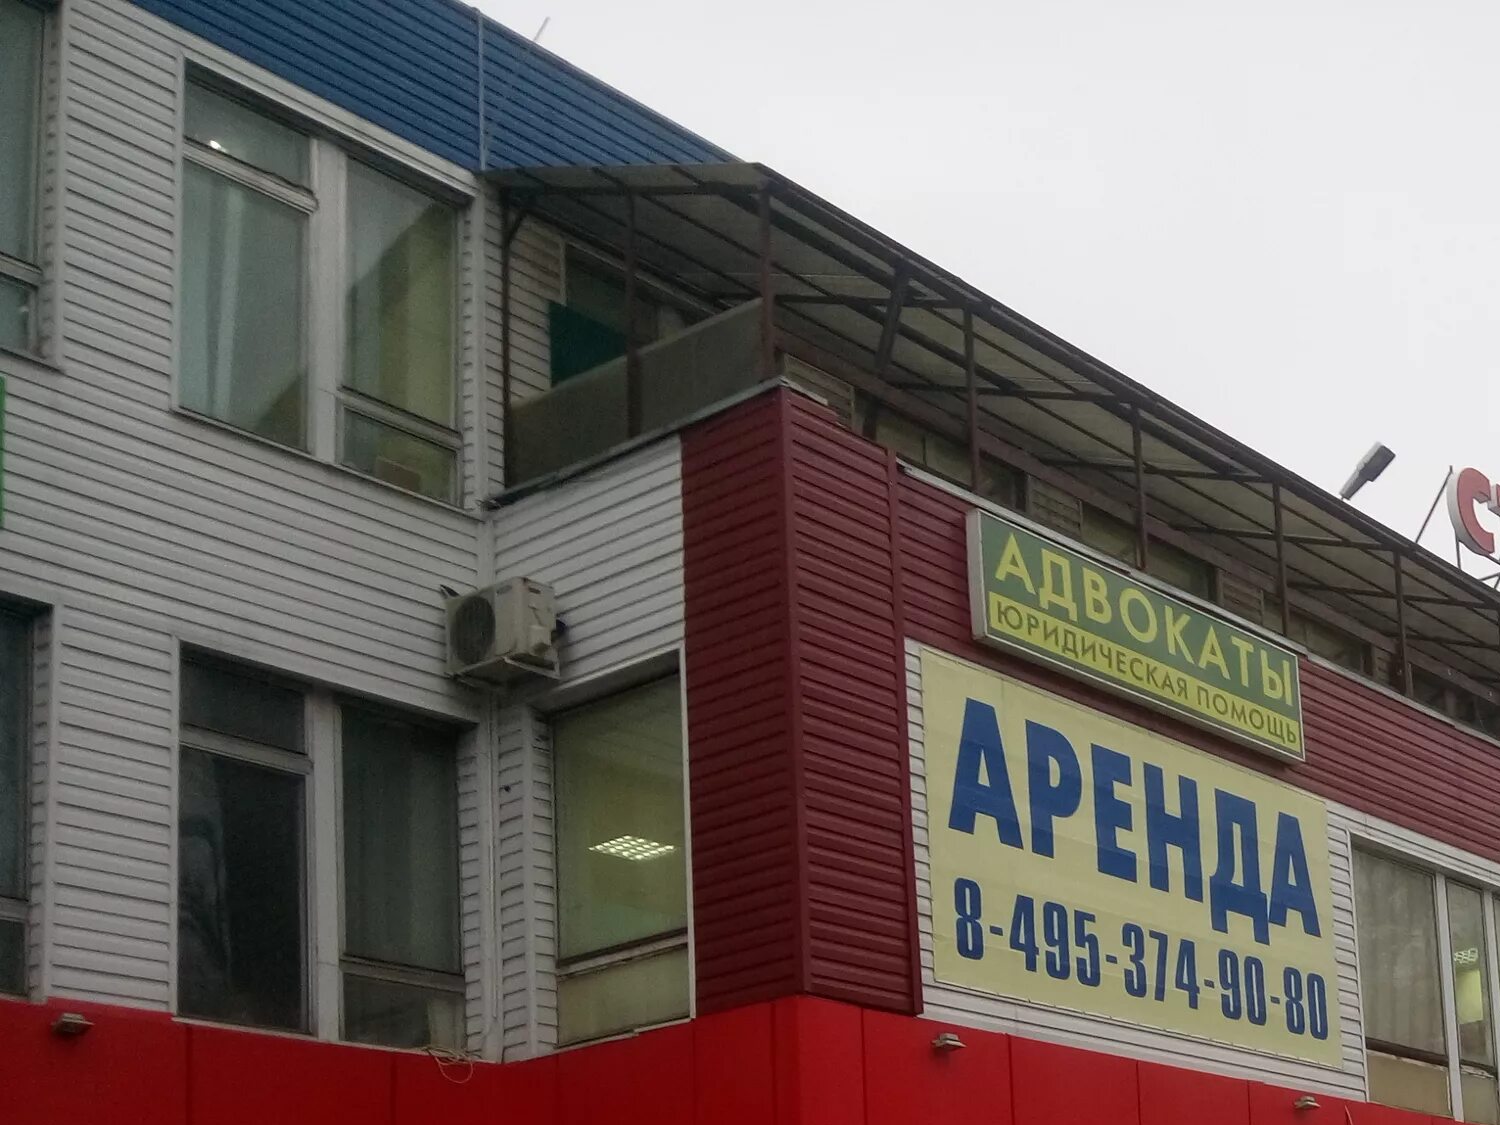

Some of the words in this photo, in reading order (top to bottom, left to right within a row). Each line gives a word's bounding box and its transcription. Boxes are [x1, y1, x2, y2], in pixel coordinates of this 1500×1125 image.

[995, 532, 1294, 706] АДВОКАТЫ
[996, 600, 1190, 701] ЮРИДИЧЕСКАЯ
[1197, 684, 1298, 745] ПОМОЩЬ
[948, 697, 1322, 946] АРЕНДА
[954, 877, 1330, 1041] 8-495-374-90-80
